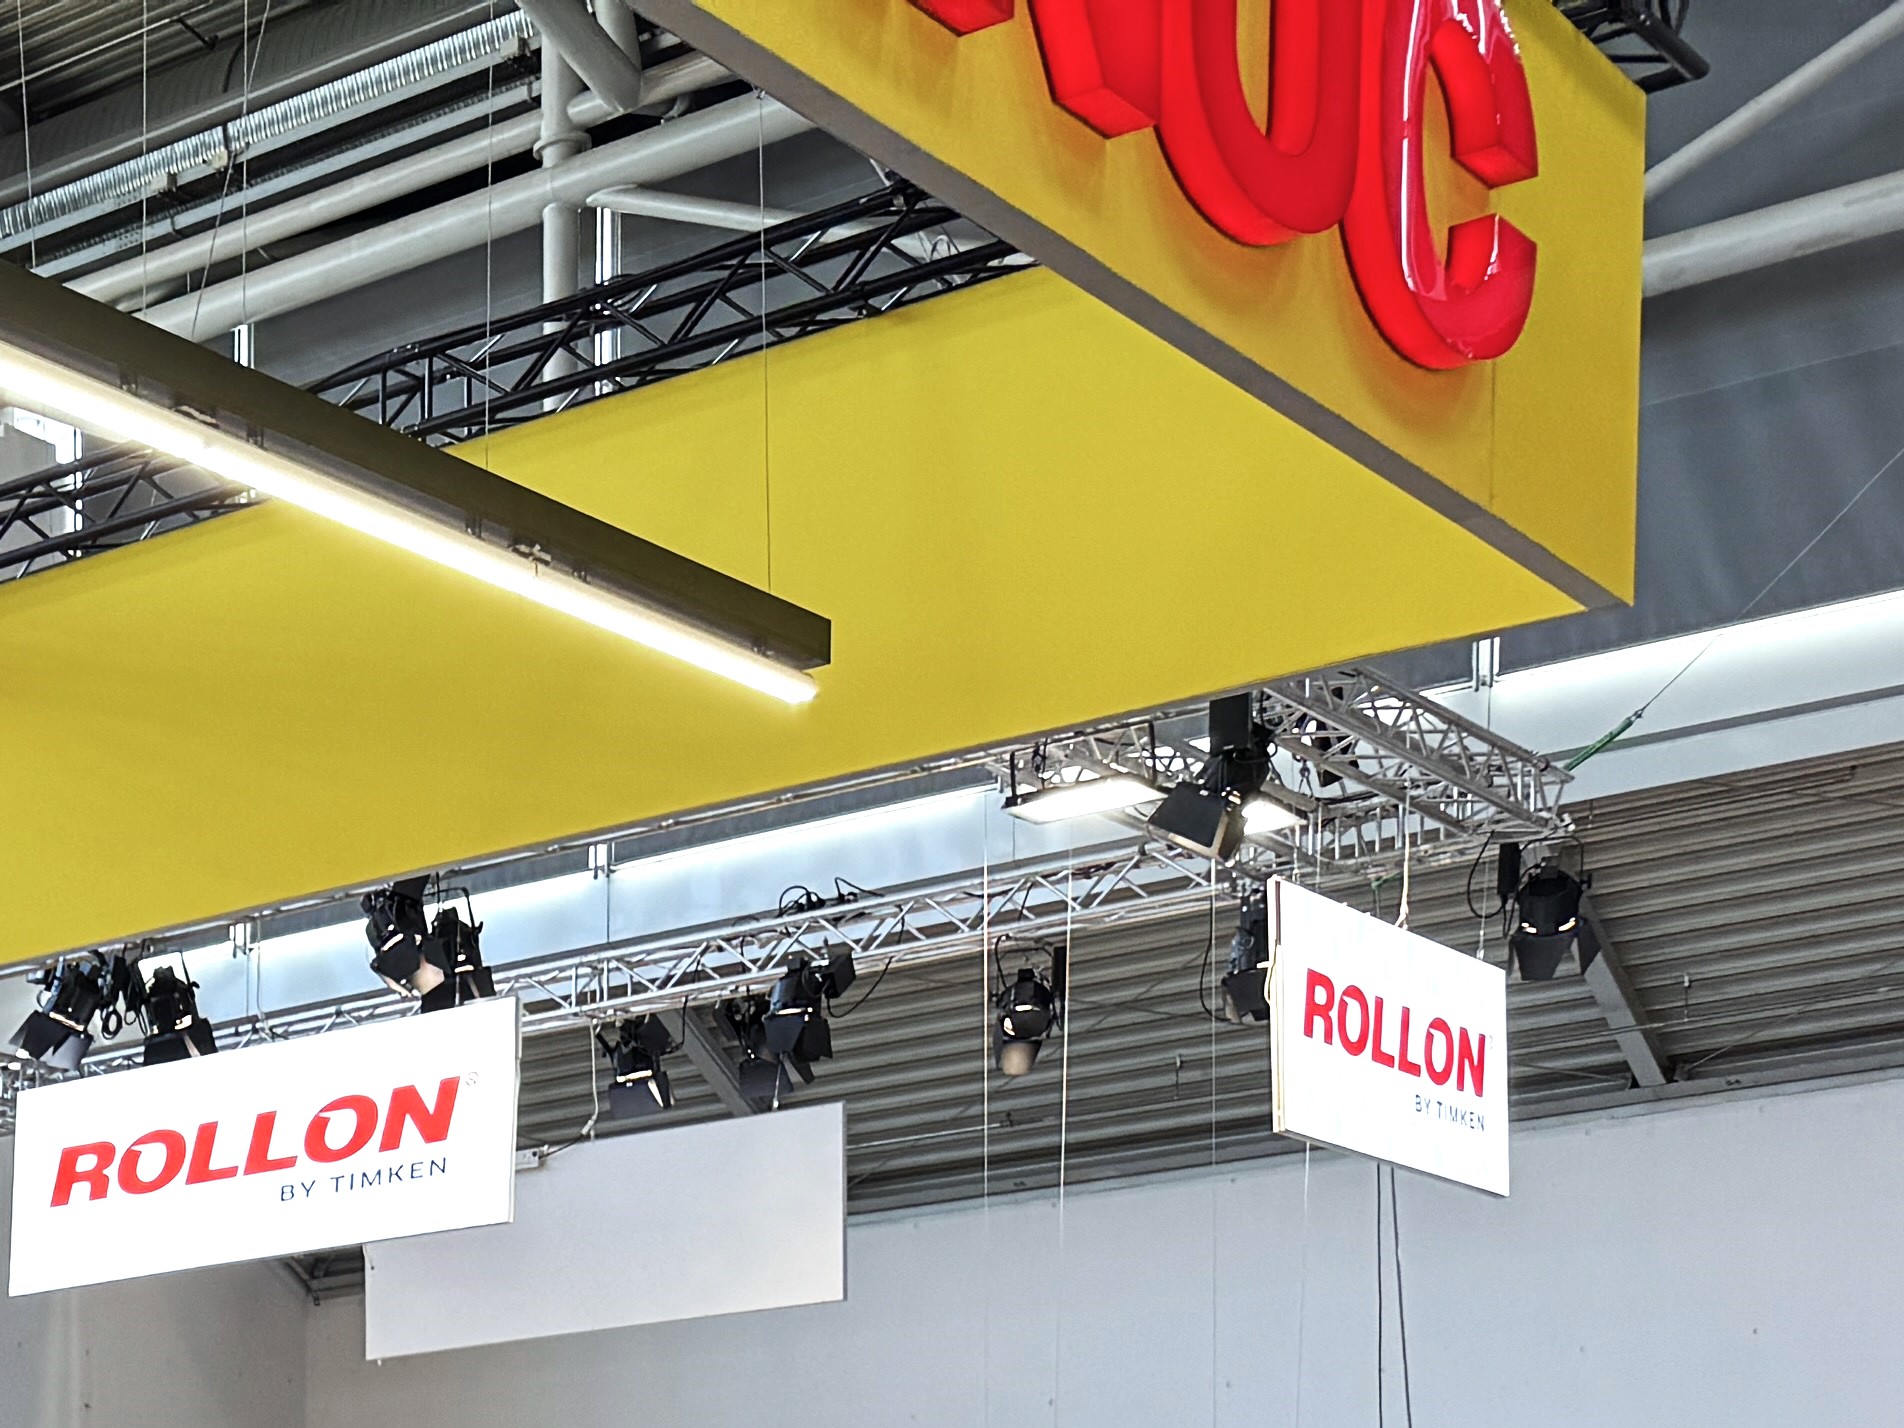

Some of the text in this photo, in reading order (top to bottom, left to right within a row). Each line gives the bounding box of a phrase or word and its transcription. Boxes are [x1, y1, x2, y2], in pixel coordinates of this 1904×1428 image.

[1304, 968, 1487, 1098] ROLLON
[50, 1075, 462, 1207] ROLLON
[1414, 1094, 1486, 1132] BY TIMKEN
[279, 1156, 448, 1202] BY TIMKEN
